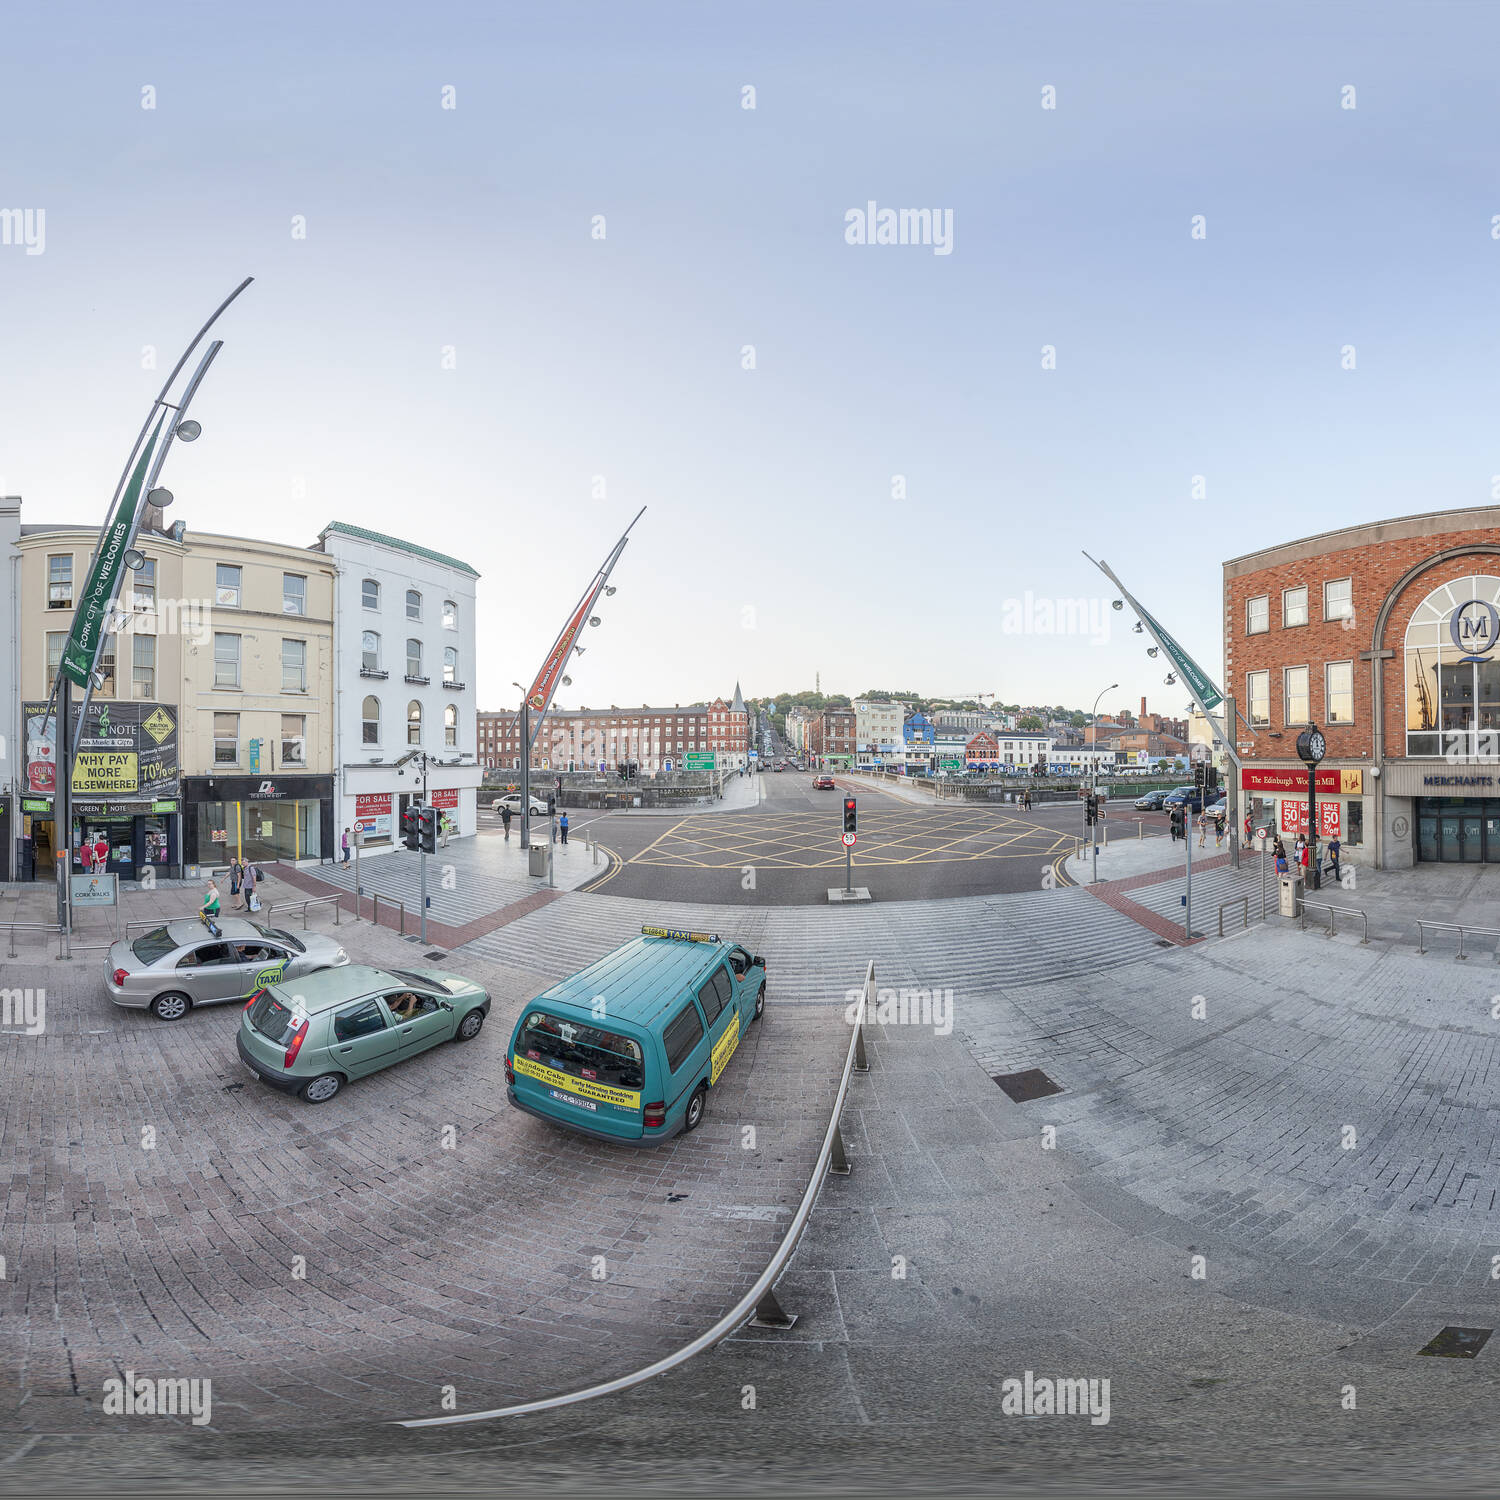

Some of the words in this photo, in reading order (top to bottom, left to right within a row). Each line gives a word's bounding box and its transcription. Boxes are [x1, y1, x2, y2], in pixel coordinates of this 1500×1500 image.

[99, 522, 127, 581] WELCOMES
[95, 581, 105, 597] OF
[86, 597, 101, 620] CITY
[79, 622, 92, 648] CORK
[1183, 662, 1205, 690] WELCOMES
[71, 705, 101, 715] GREN
[109, 725, 137, 735] NOTE
[79, 755, 104, 766] WHY
[109, 755, 129, 766] PAY
[34, 766, 53, 776] CORK
[88, 767, 121, 778] MORE
[141, 761, 168, 782] 70%
[168, 766, 177, 775] OFF
[72, 780, 136, 791] ELSEWHERE?
[1264, 776, 1293, 786] Edinburgh
[1321, 777, 1335, 786] Mill
[1423, 775, 1493, 787] MERCHANTS
[373, 794, 392, 803] SALE
[1283, 801, 1298, 809] SALE
[1323, 803, 1338, 811] SALE
[1284, 809, 1298, 821] 50
[1323, 811, 1338, 825] 50
[1284, 821, 1298, 832] %off
[1324, 824, 1339, 835] %off
[669, 931, 690, 940] TAXI
[259, 975, 279, 985] TAXI
[547, 1070, 566, 1082] Cabs
[571, 1078, 585, 1088] Early
[585, 1083, 608, 1093] Morning
[609, 1088, 634, 1100] Booking
[578, 1087, 625, 1103] GUARANTEED
